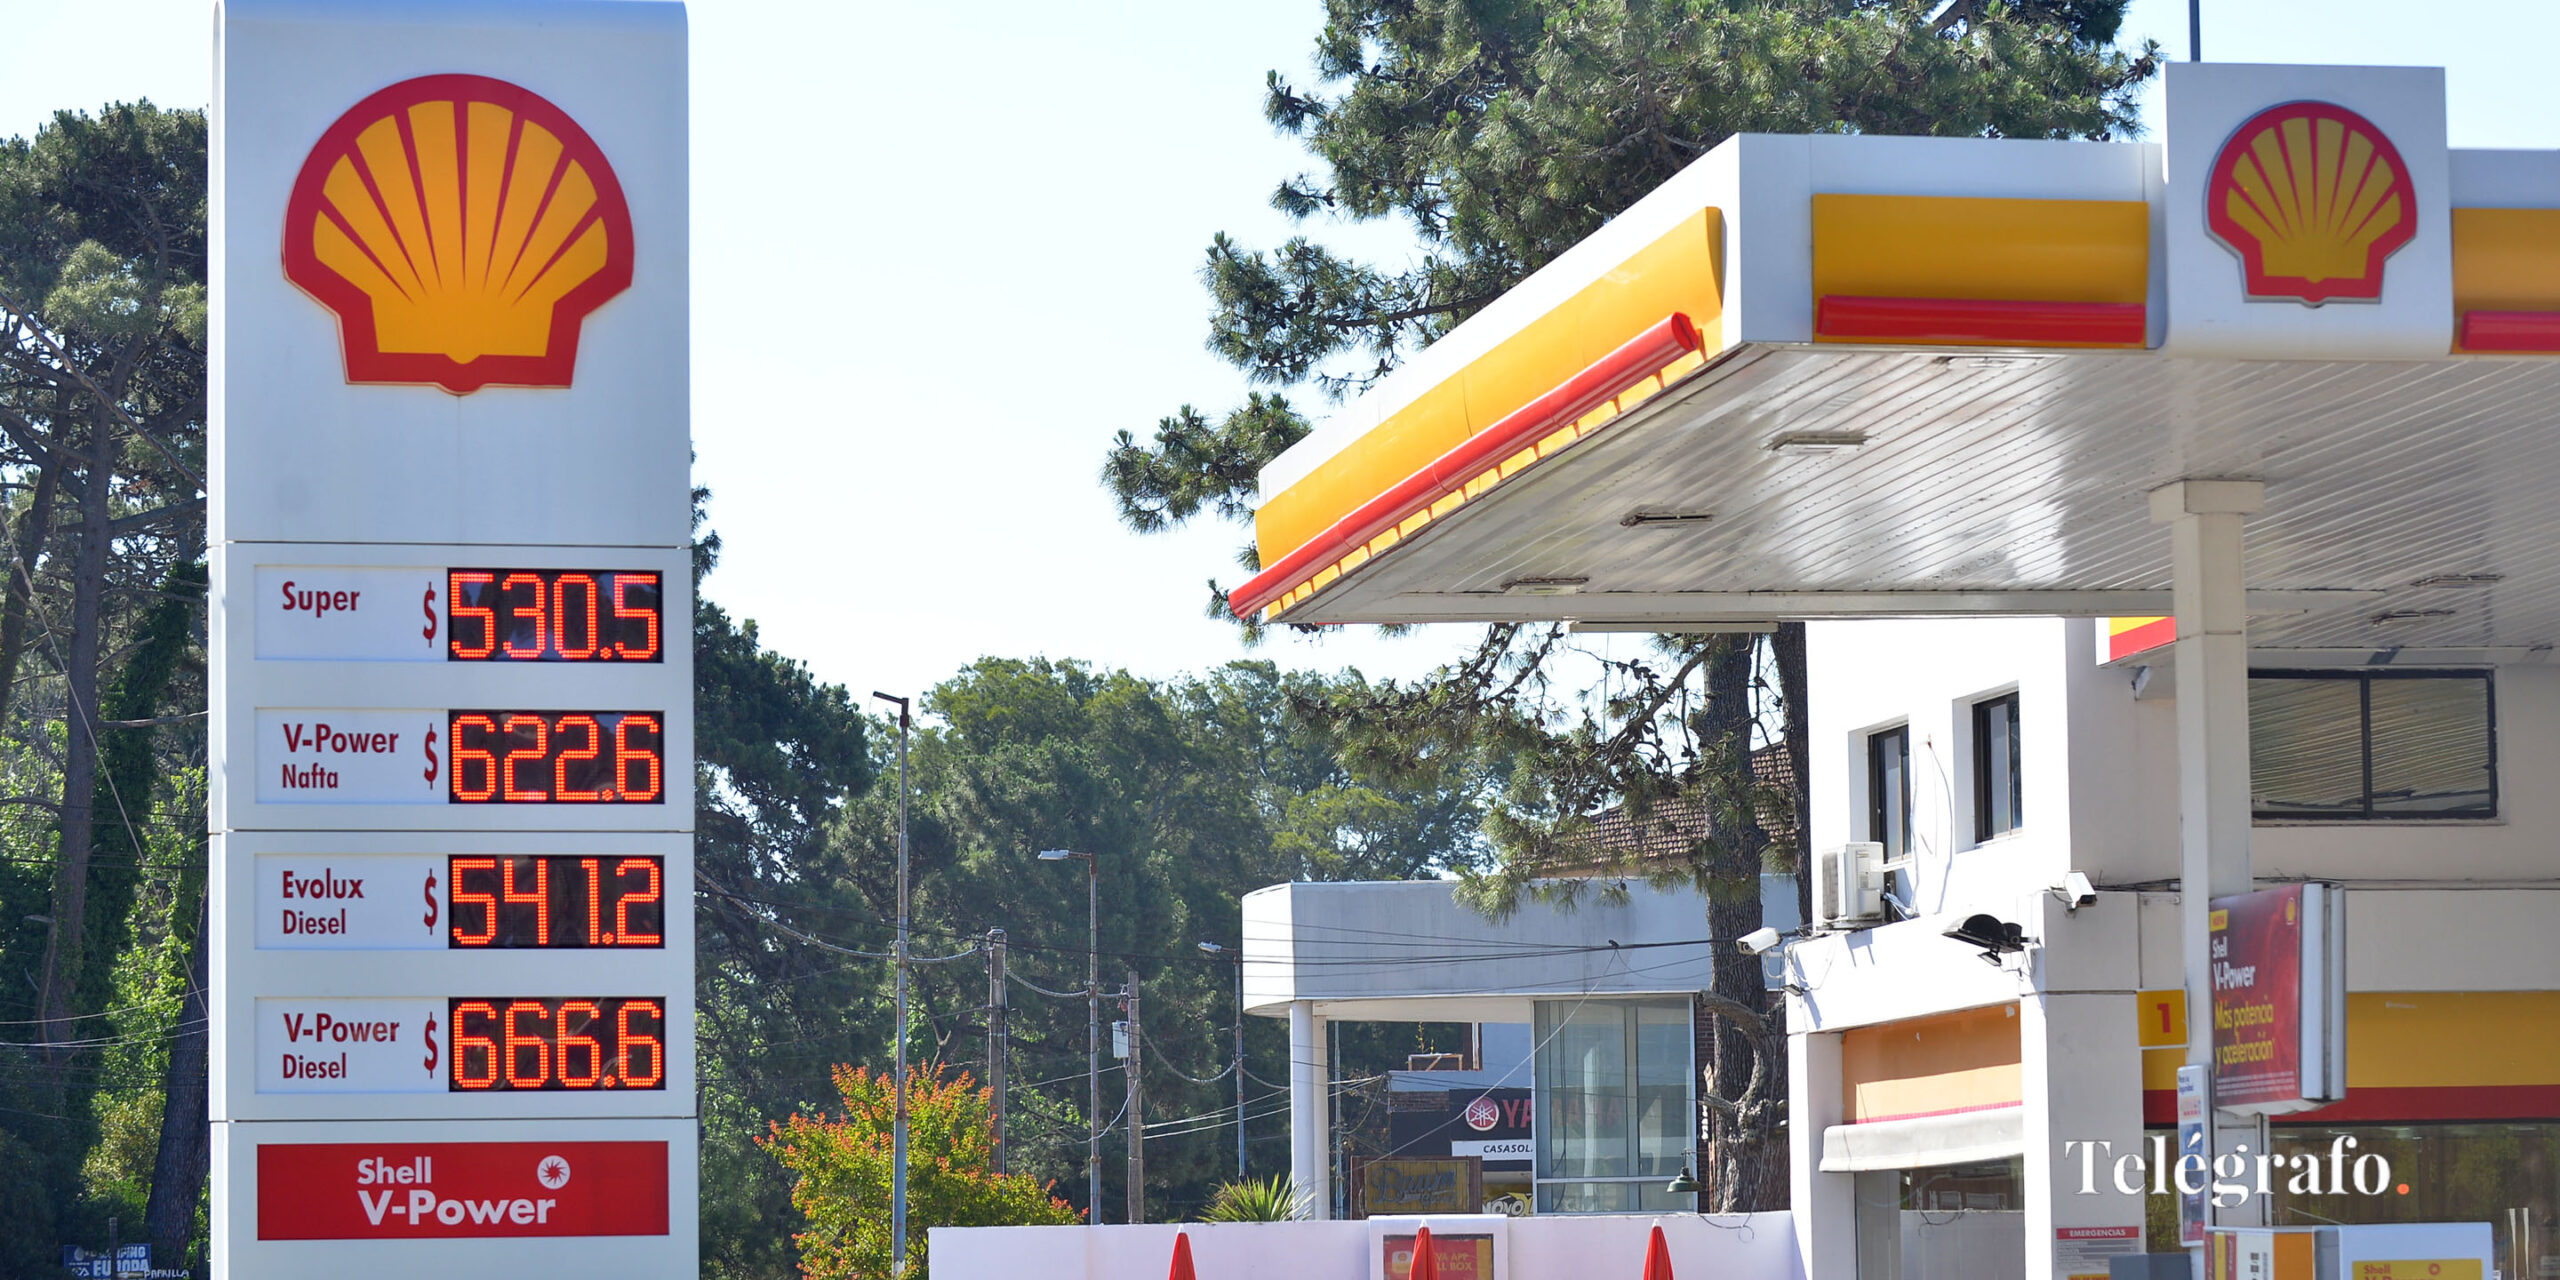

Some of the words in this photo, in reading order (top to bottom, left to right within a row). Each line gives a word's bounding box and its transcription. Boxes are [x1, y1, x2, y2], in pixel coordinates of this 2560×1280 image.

[282, 581, 360, 618] Super
[423, 582, 437, 648] $
[450, 572, 659, 660] 530.5
[282, 723, 399, 754] V-Power
[423, 723, 438, 790] $
[452, 714, 660, 802] 622.6
[282, 762, 339, 789] Nafta
[282, 867, 364, 900] Evolux
[423, 868, 438, 935] $
[452, 857, 660, 945] 541.2
[282, 908, 346, 935] Diesel
[2213, 936, 2228, 959] Shell
[2213, 961, 2255, 991] V-Power
[282, 1012, 401, 1043] V-Power
[2157, 1003, 2171, 1033] 1
[2215, 1000, 2233, 1030] Más
[2234, 994, 2274, 1034] potencia
[423, 1012, 438, 1079] $
[452, 1001, 661, 1089] 666.6
[282, 1052, 347, 1080] Diesel
[2215, 1047, 2222, 1075] y
[1483, 1144, 1533, 1154] CASASOL
[357, 1156, 432, 1184] Shell
[357, 1190, 556, 1226] V-Power
[2069, 1229, 2126, 1238] EMERGENCIAS
[2363, 1264, 2391, 1274] Shell
